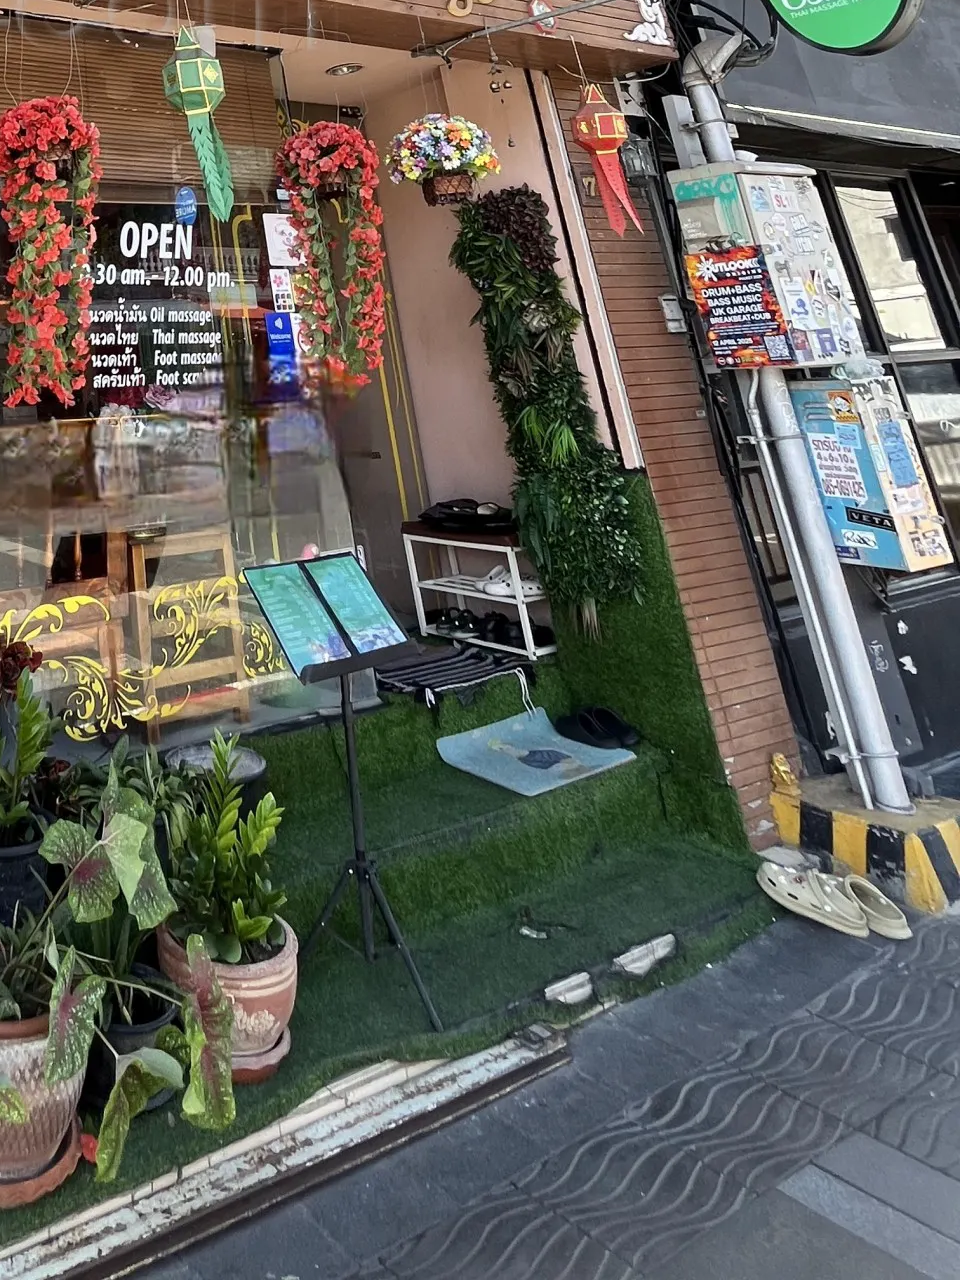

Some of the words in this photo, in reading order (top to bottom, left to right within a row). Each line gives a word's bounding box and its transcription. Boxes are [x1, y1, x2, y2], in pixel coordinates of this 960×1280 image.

[790, 8, 809, 19] THAI
[810, 0, 848, 14] MASSAGE
[120, 221, 193, 259] OPEN
[120, 269, 151, 286] am.
[163, 266, 204, 286] 12.00
[207, 271, 235, 292] pm.
[89, 297, 147, 322] นวดน้ำมัน
[707, 297, 731, 307] BASS
[731, 294, 762, 305] MUSIC
[712, 307, 726, 316] UK
[726, 304, 764, 314] GARAGE
[150, 307, 165, 322] Oil
[168, 310, 211, 326] massage
[90, 324, 139, 345] นวดไทย
[152, 329, 175, 344] Thai
[178, 332, 221, 347] massage
[91, 347, 137, 368] นวดเท้า
[154, 350, 177, 365] Foot
[93, 367, 145, 389] สครับเท้า
[156, 370, 180, 385] Foot
[851, 511, 892, 528] VETA
